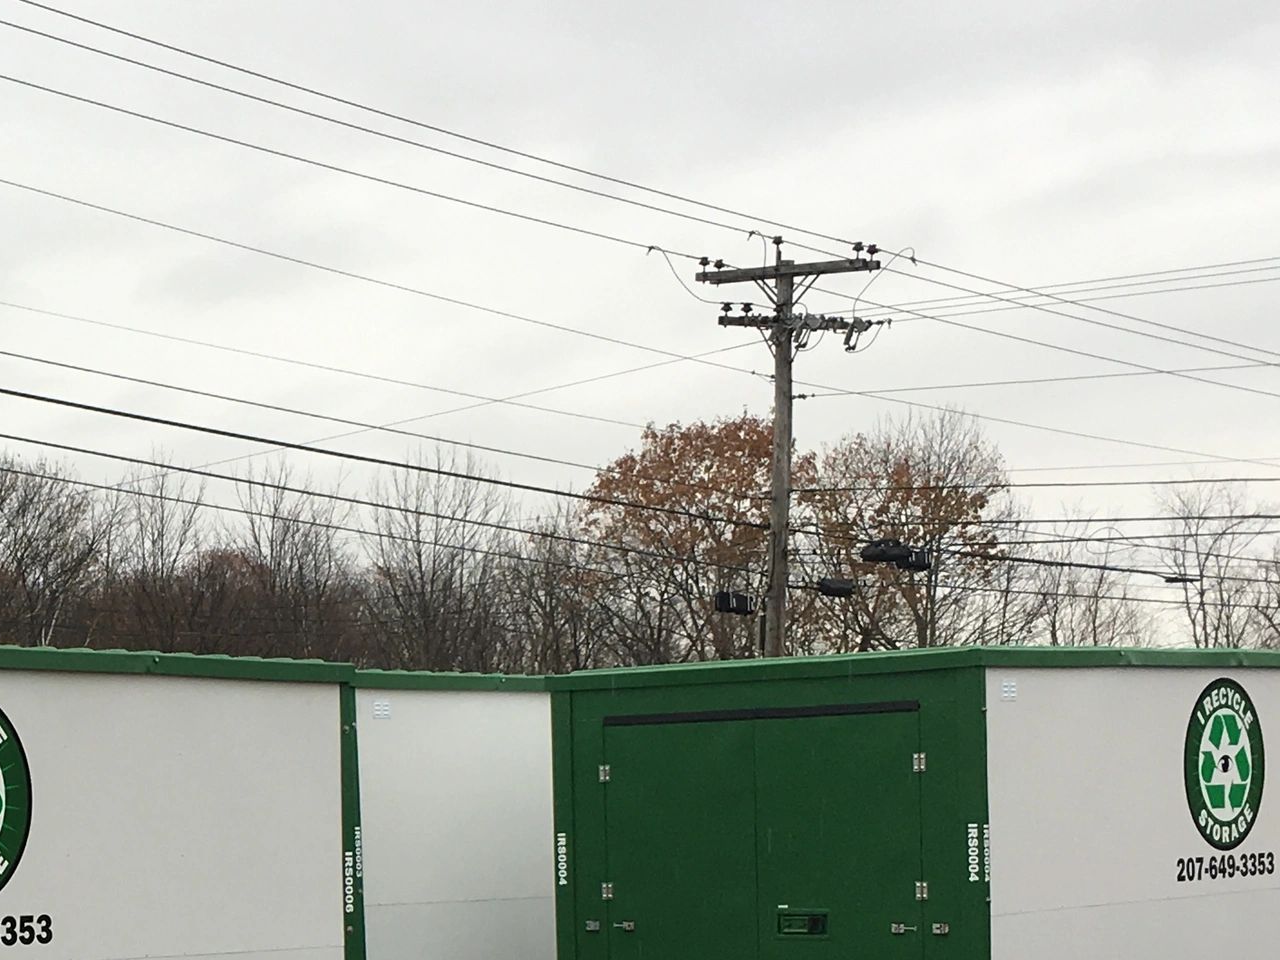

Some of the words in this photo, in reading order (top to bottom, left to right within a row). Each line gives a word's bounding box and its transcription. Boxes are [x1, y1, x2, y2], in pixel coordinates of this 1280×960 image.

[1197, 710, 1205, 725] I
[1203, 687, 1254, 730] RECYCLE
[1198, 803, 1253, 844] STORAGE
[557, 833, 567, 885] IRS0004
[967, 823, 979, 882] IRS0004
[1177, 852, 1275, 882] 207-649-3353
[344, 851, 354, 913] IRS0006
